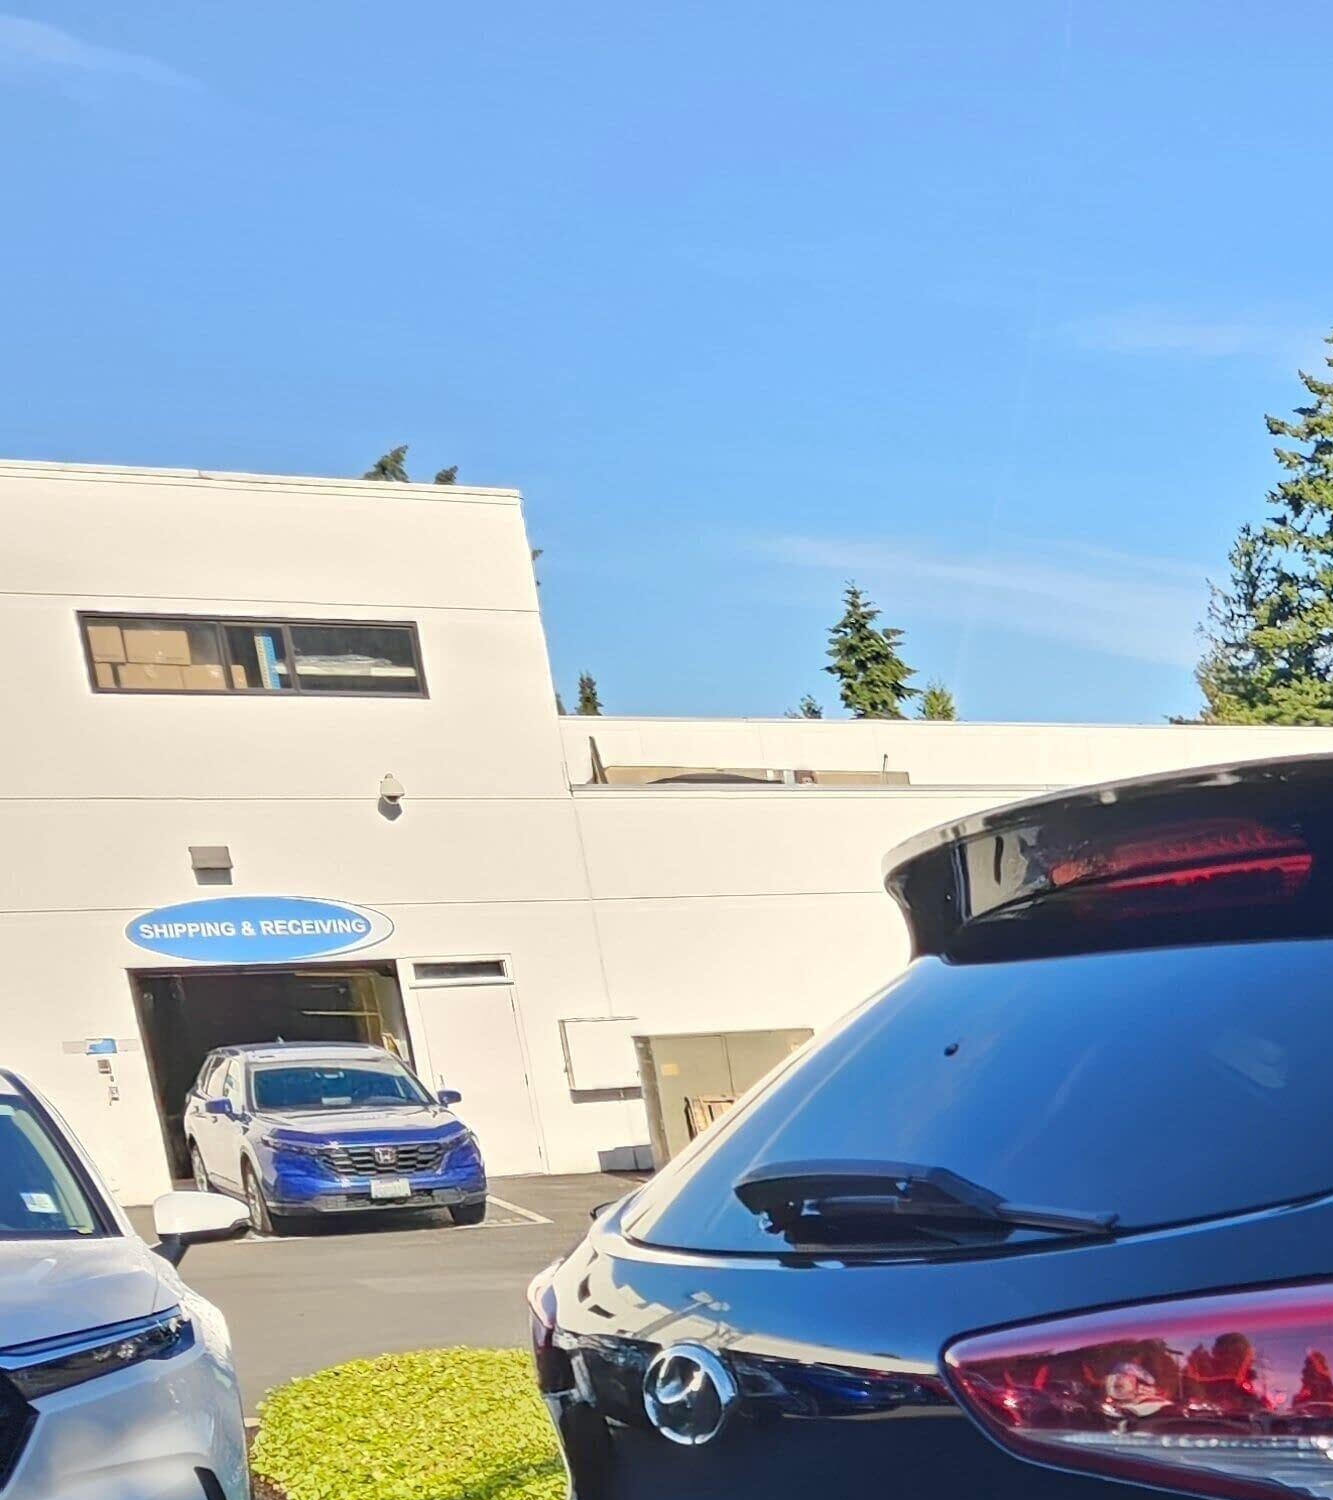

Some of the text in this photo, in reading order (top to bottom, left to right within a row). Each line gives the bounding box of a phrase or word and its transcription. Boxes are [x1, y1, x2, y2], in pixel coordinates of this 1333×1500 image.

[138, 918, 367, 939] SHIPPING & RECEIVING
